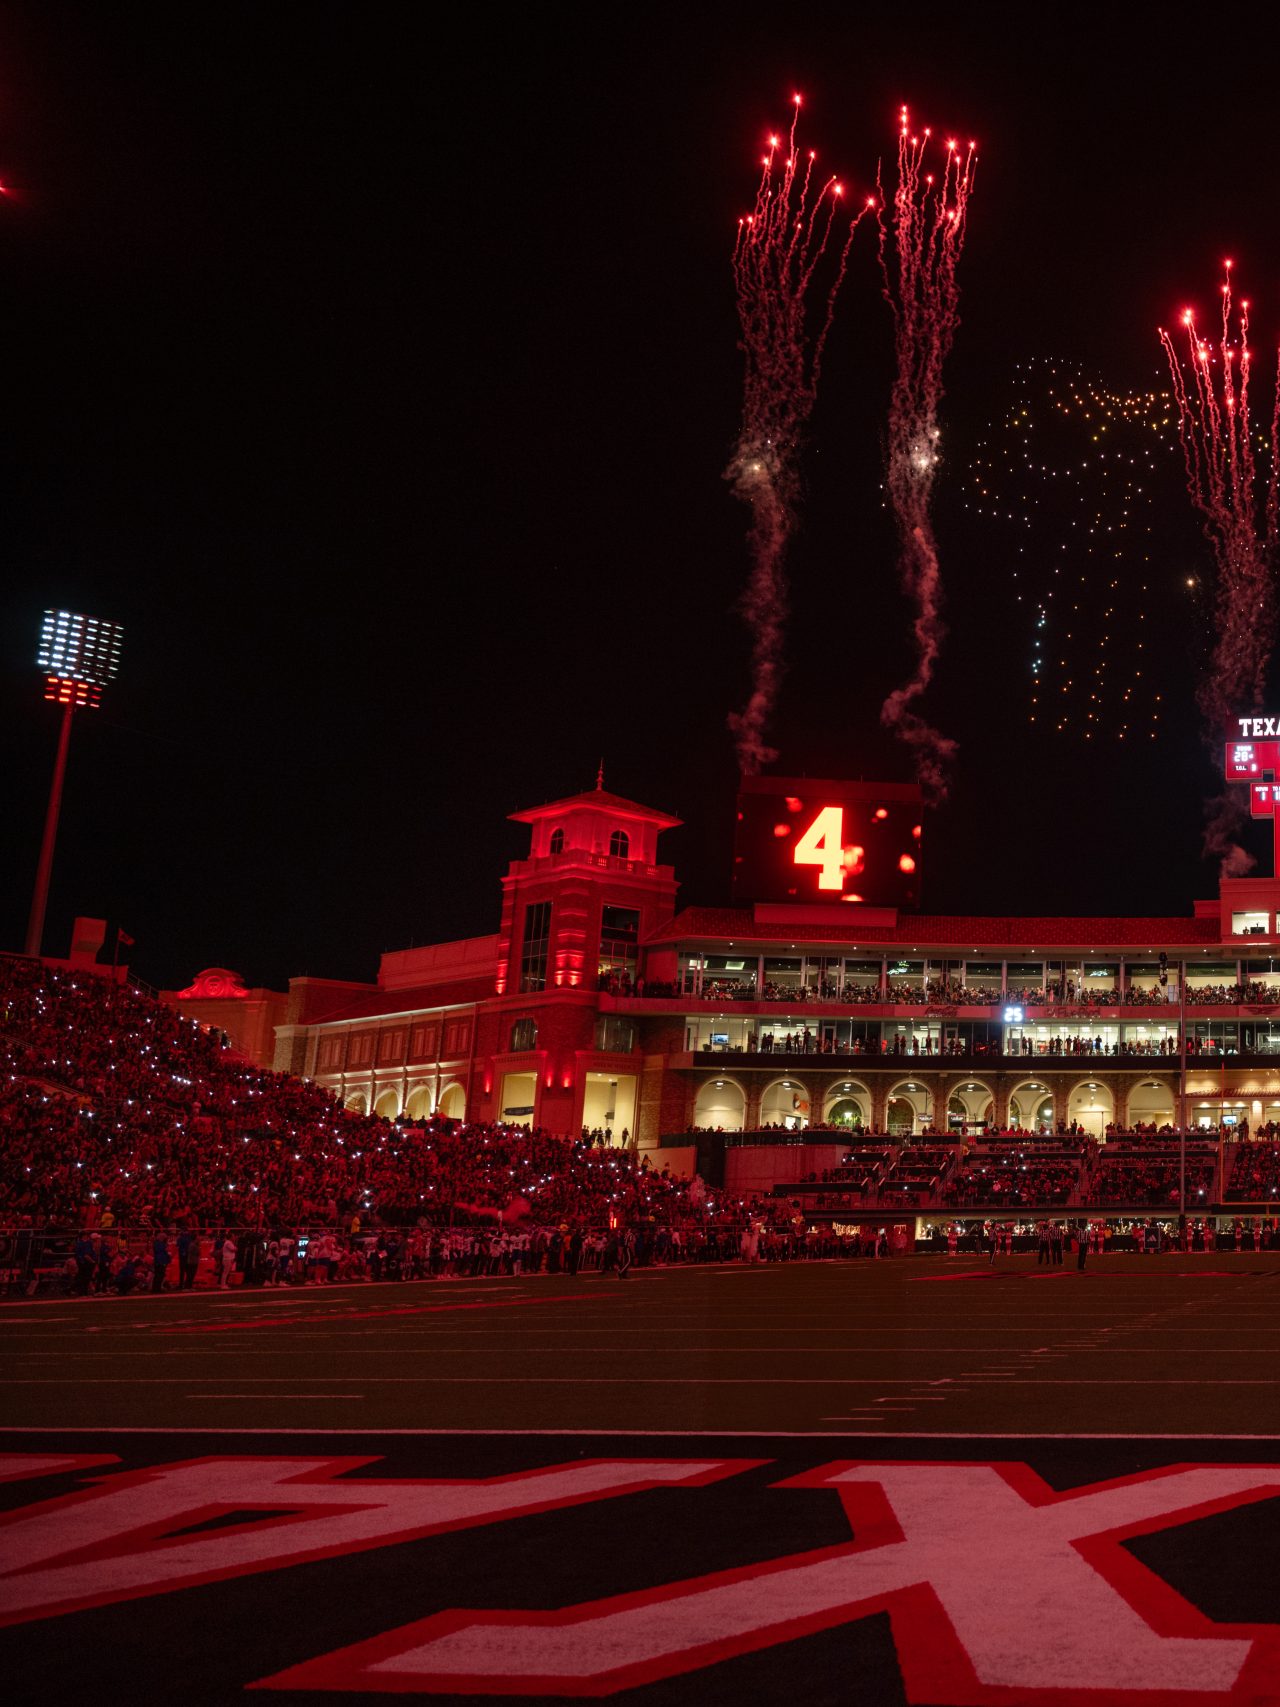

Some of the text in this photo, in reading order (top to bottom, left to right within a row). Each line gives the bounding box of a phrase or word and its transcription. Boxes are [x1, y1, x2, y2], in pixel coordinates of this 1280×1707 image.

[1234, 752, 1248, 762] 28
[794, 807, 844, 890] 4
[1004, 1007, 1023, 1022] 25
